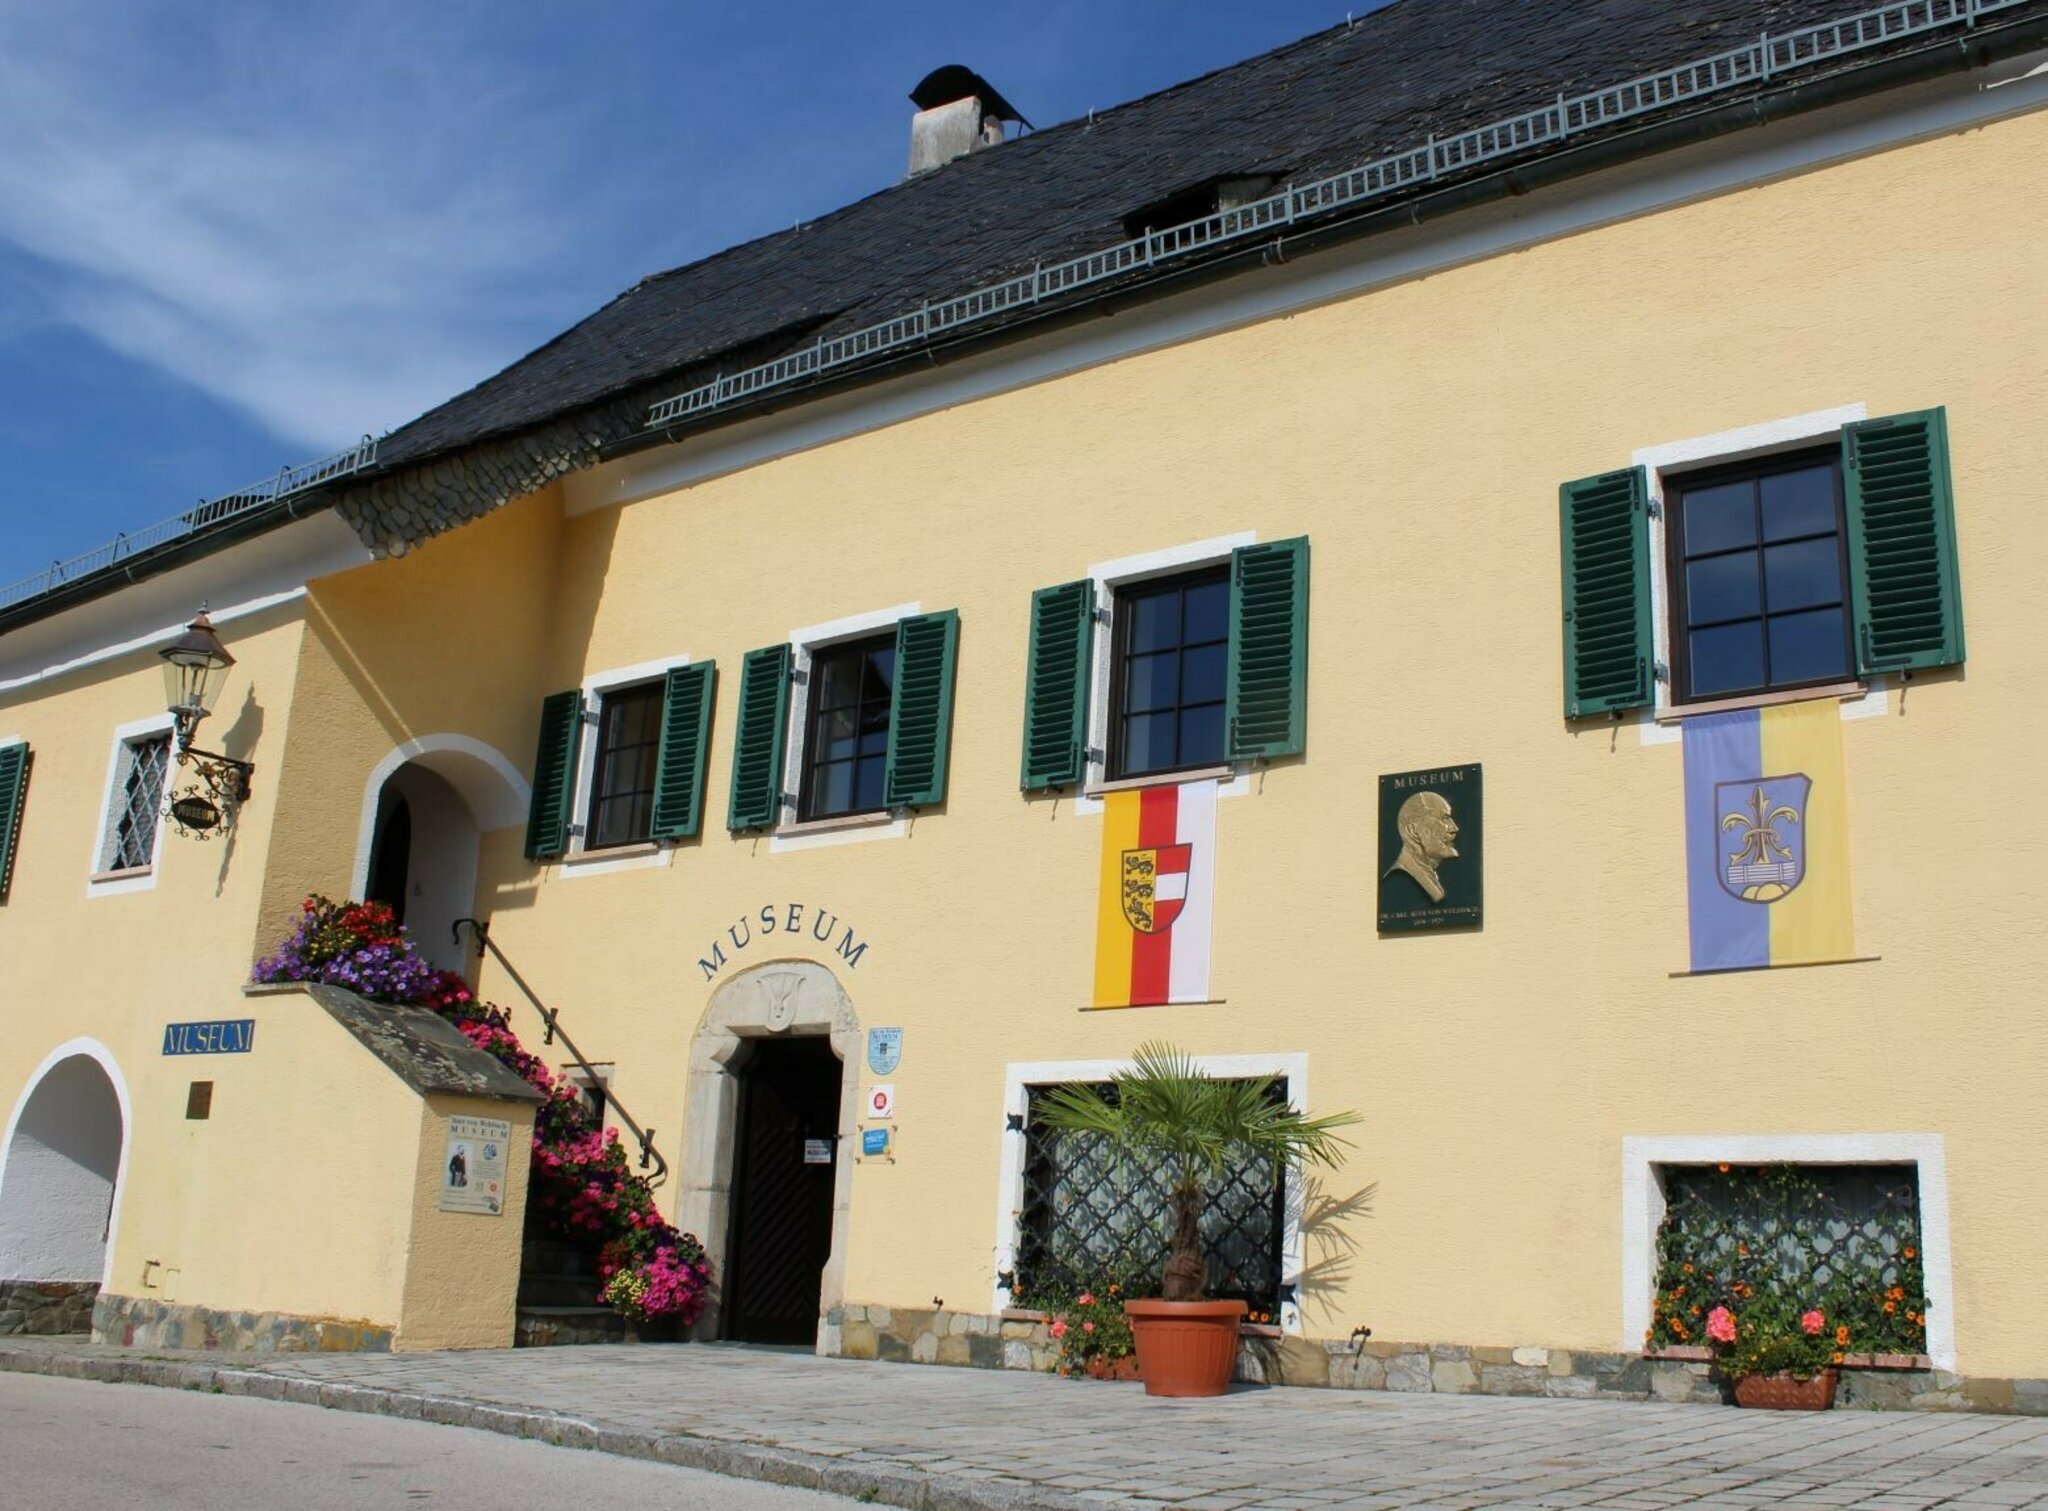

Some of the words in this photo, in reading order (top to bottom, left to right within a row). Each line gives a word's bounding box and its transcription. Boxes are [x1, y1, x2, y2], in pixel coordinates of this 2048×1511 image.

[1394, 770, 1464, 789] MUSEUM
[177, 803, 215, 822] MUSEUM
[698, 903, 869, 982] MUSEUM
[164, 1022, 254, 1053] MUSEUM
[451, 1125, 508, 1138] MUSEUM
